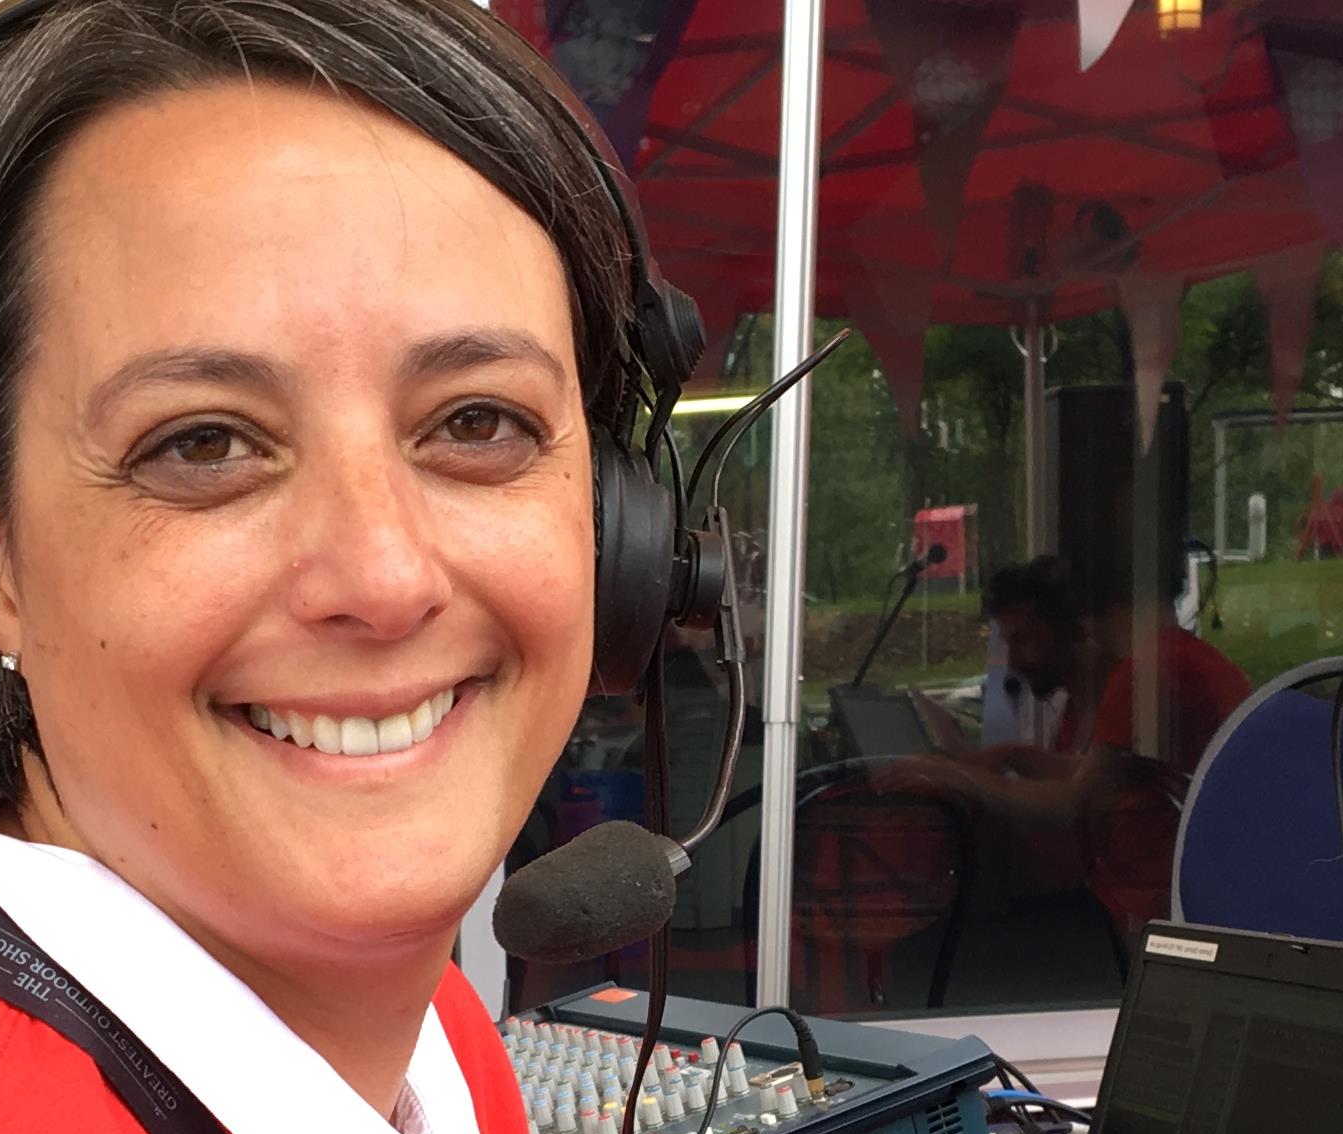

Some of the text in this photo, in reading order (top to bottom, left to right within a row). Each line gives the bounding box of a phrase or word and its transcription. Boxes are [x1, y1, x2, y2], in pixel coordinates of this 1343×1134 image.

[12, 971, 52, 1002] THE
[29, 957, 111, 1029] OUTDOOR
[108, 1030, 177, 1111] GREATEST
